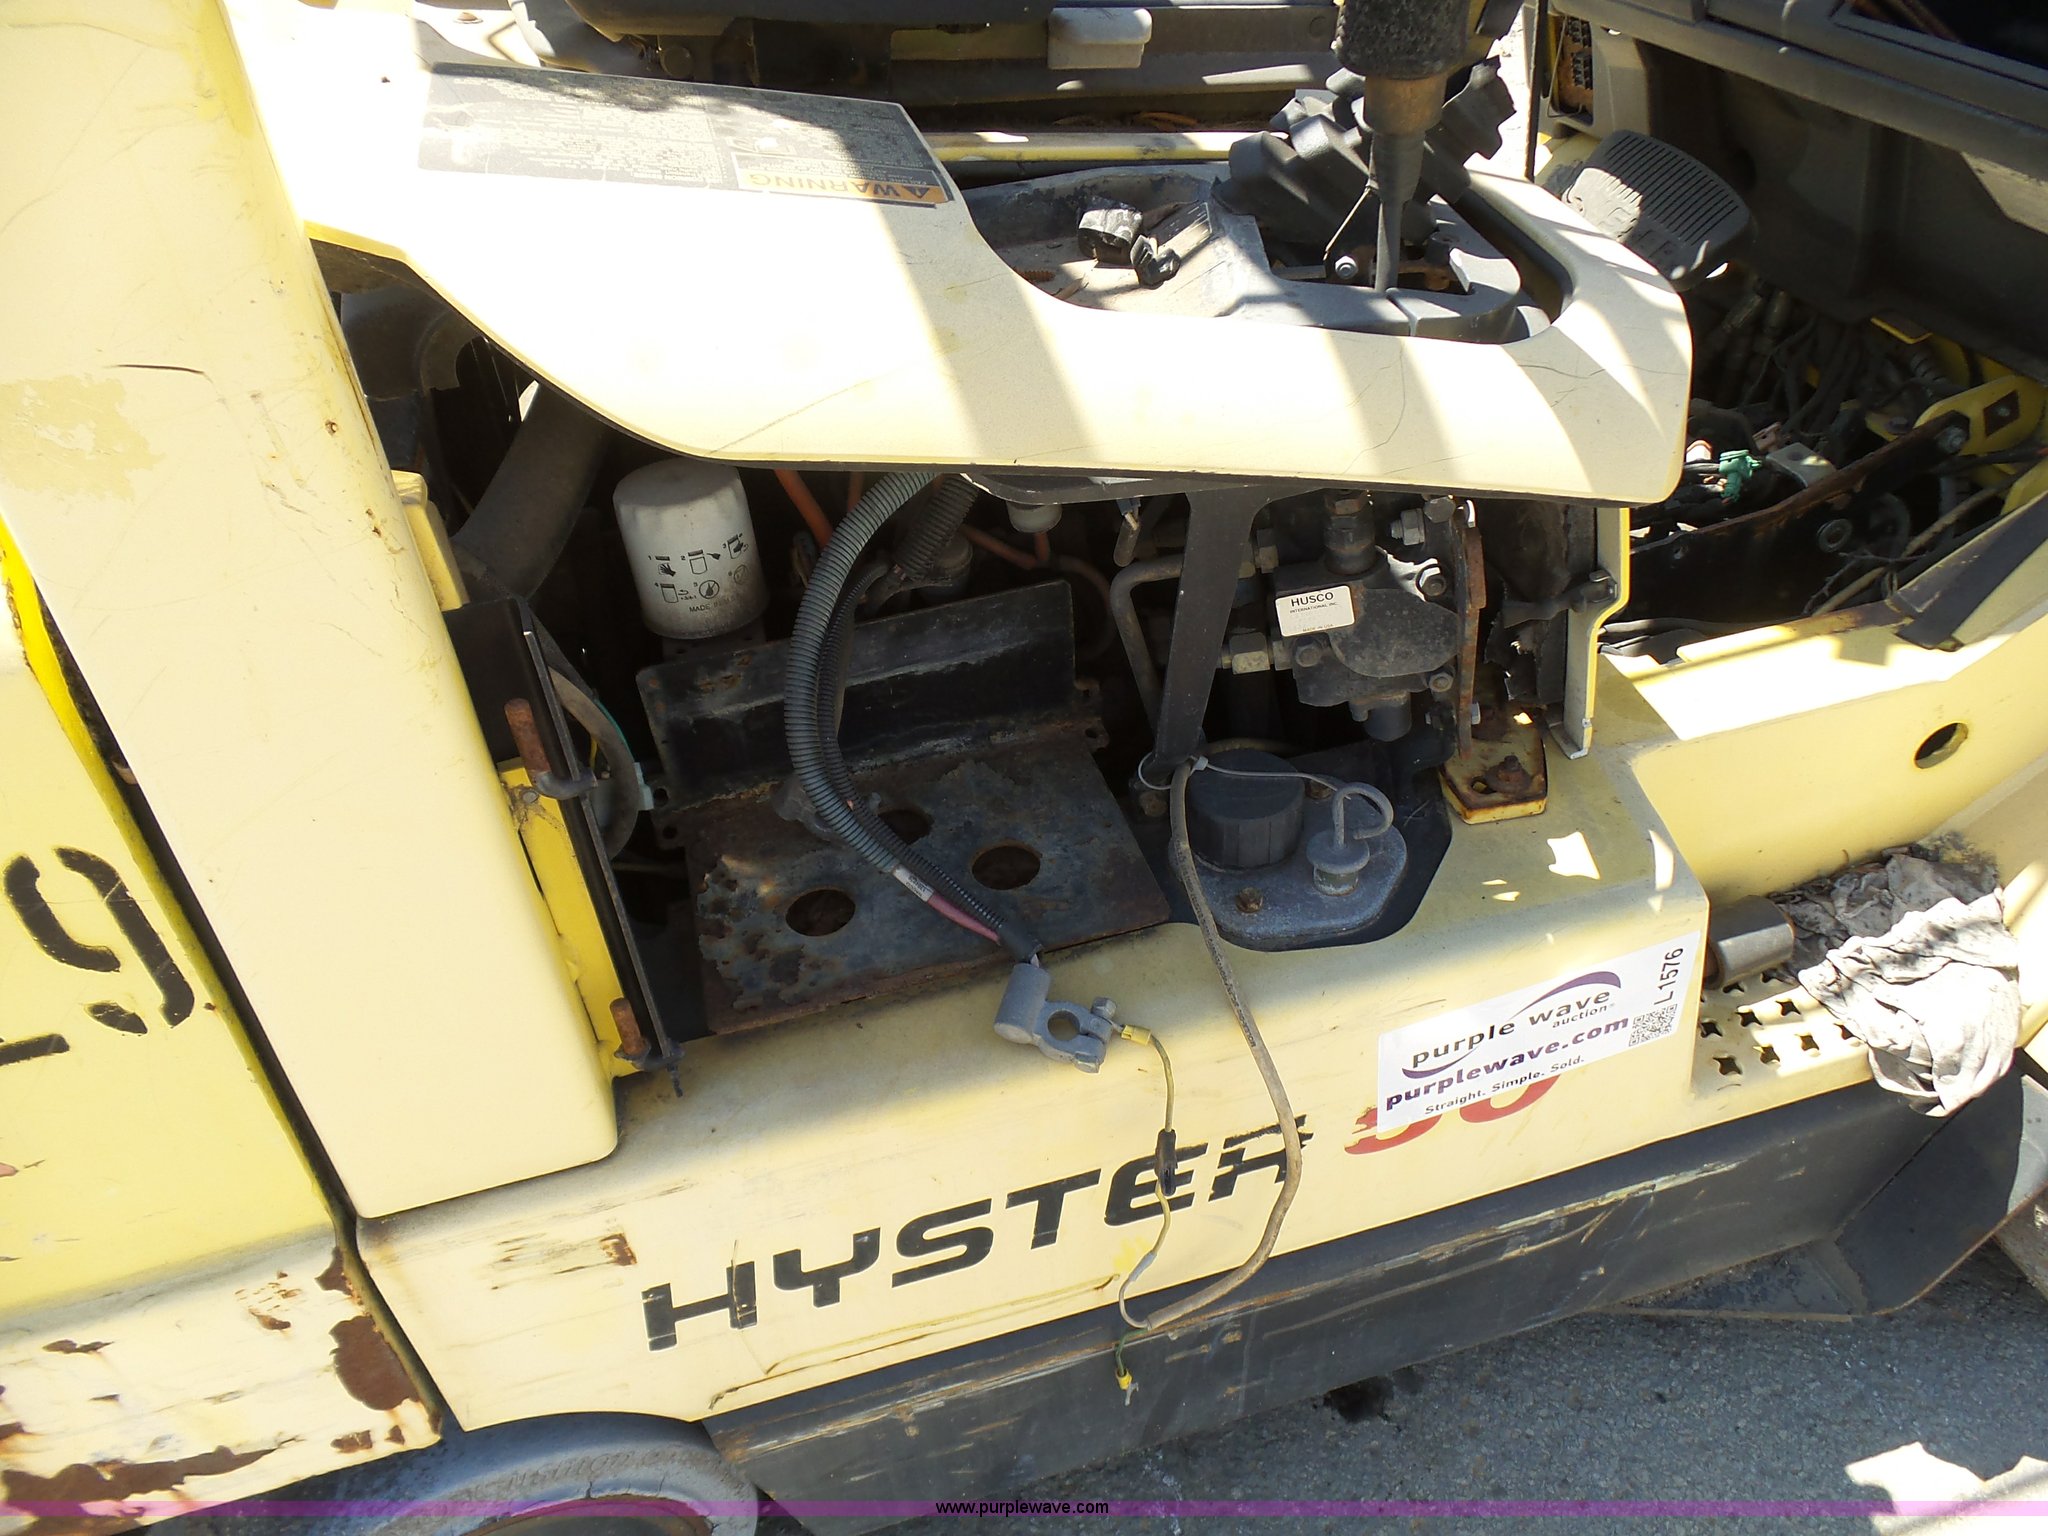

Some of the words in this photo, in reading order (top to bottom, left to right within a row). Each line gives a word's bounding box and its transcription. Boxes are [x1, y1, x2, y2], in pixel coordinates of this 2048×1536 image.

[750, 174, 900, 198] WARNING
[689, 603, 710, 612] MADE
[1290, 603, 1328, 613] INTERNATIONAL
[1291, 592, 1334, 607] HUSCO
[1653, 948, 1684, 1005] L1576
[1412, 1022, 1515, 1068] purple
[1529, 991, 1610, 1026] wave
[1386, 1018, 1629, 1111] purplewave.com
[1425, 1089, 1486, 1115] Straight.
[1491, 1072, 1545, 1093] Simple.
[1550, 1055, 1585, 1073] Sold.
[641, 1113, 1314, 1352] HYSTER
